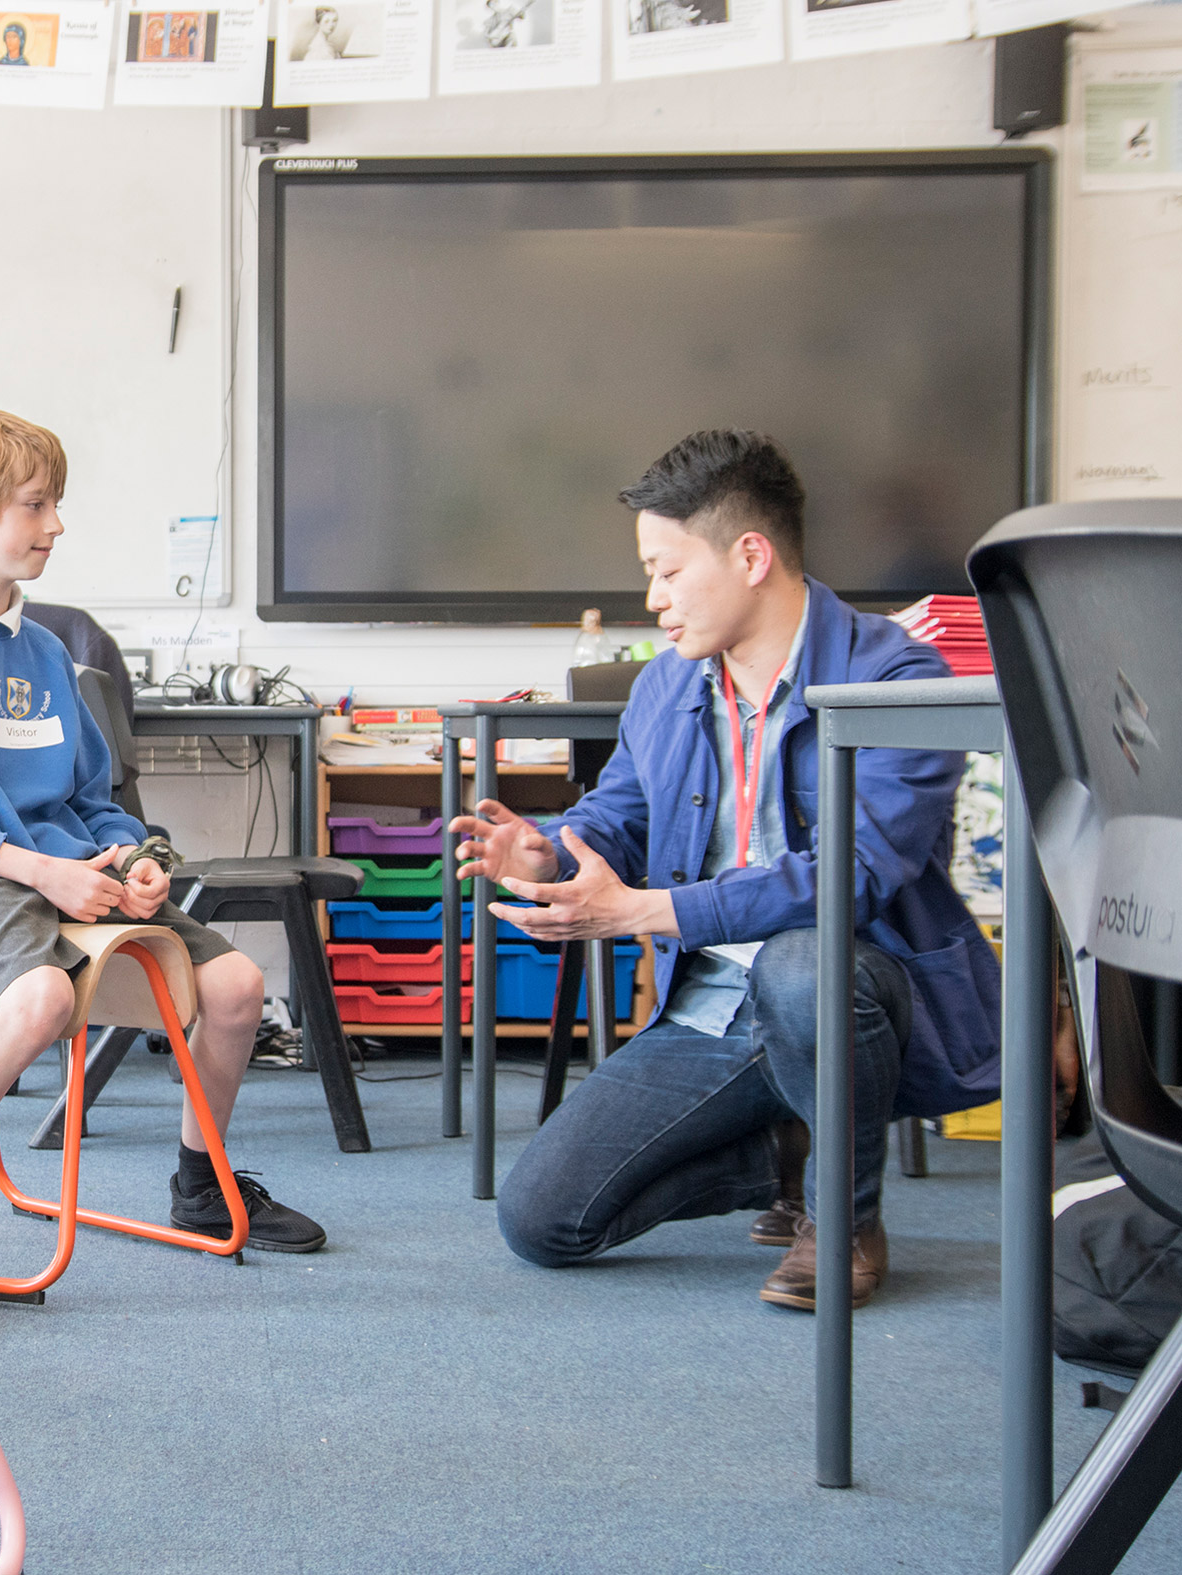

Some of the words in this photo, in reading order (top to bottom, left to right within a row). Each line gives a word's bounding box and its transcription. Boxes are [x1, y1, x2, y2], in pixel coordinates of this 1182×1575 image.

[274, 159, 335, 170] CLEVERTOUCH
[336, 159, 359, 169] PLUS
[151, 636, 168, 646] Ms
[170, 636, 213, 646] Madden
[6, 727, 38, 738] Visitor
